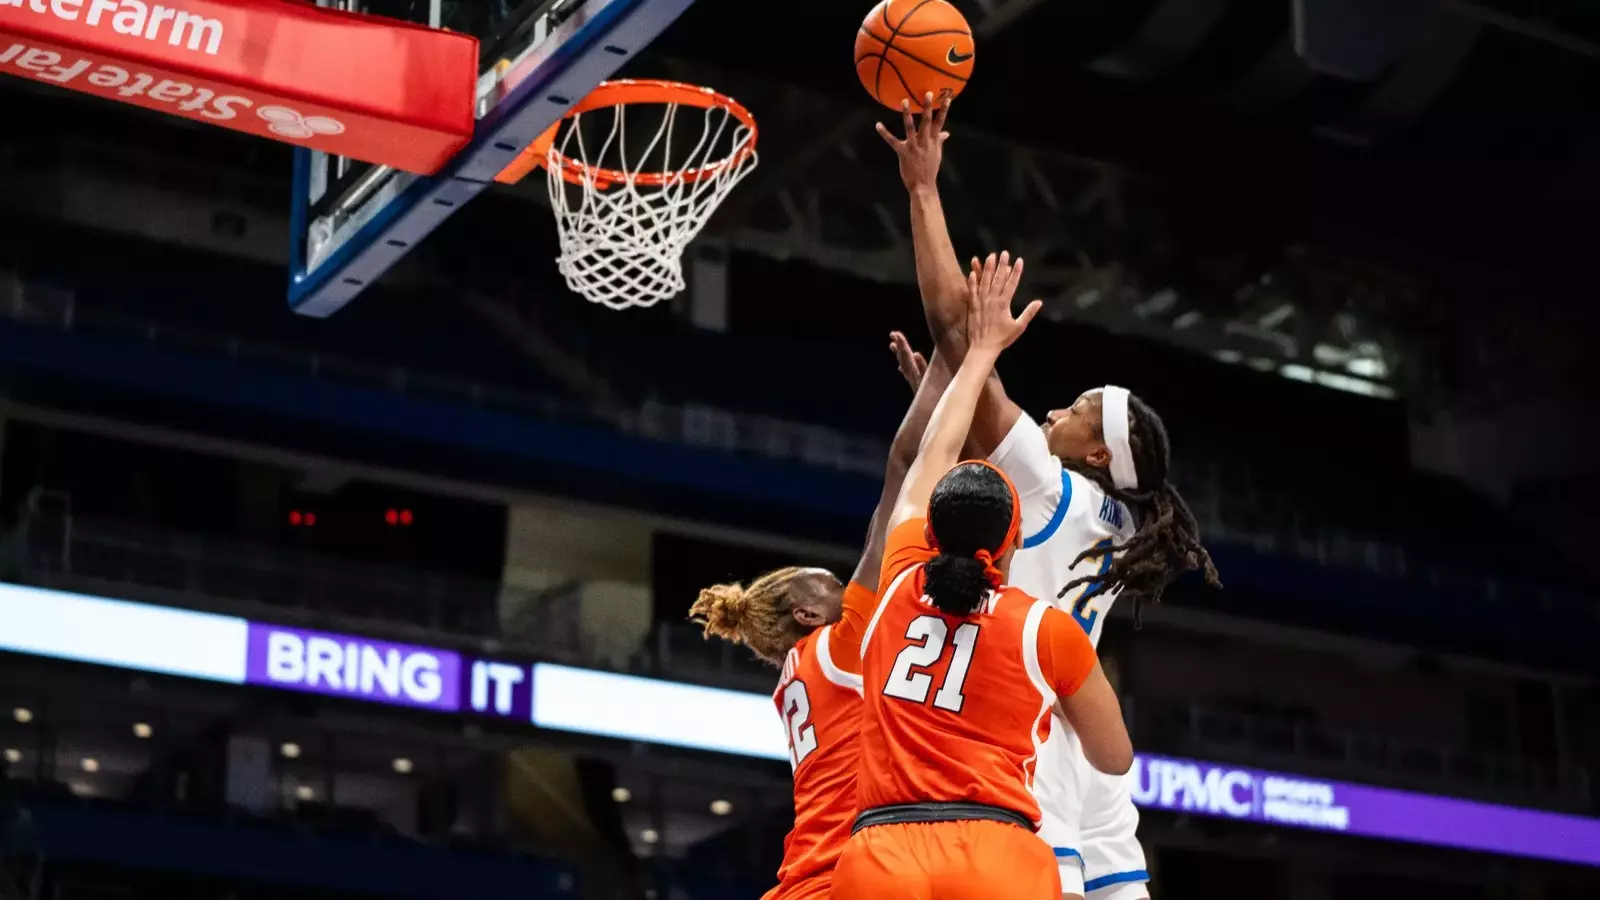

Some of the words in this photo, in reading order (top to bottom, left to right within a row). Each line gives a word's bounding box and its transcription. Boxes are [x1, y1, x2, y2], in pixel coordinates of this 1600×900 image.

[266, 630, 443, 703] BRING
[471, 660, 525, 715] IT
[882, 614, 981, 714] 21
[780, 678, 819, 777] 2
[1131, 756, 1251, 818] UPMC
